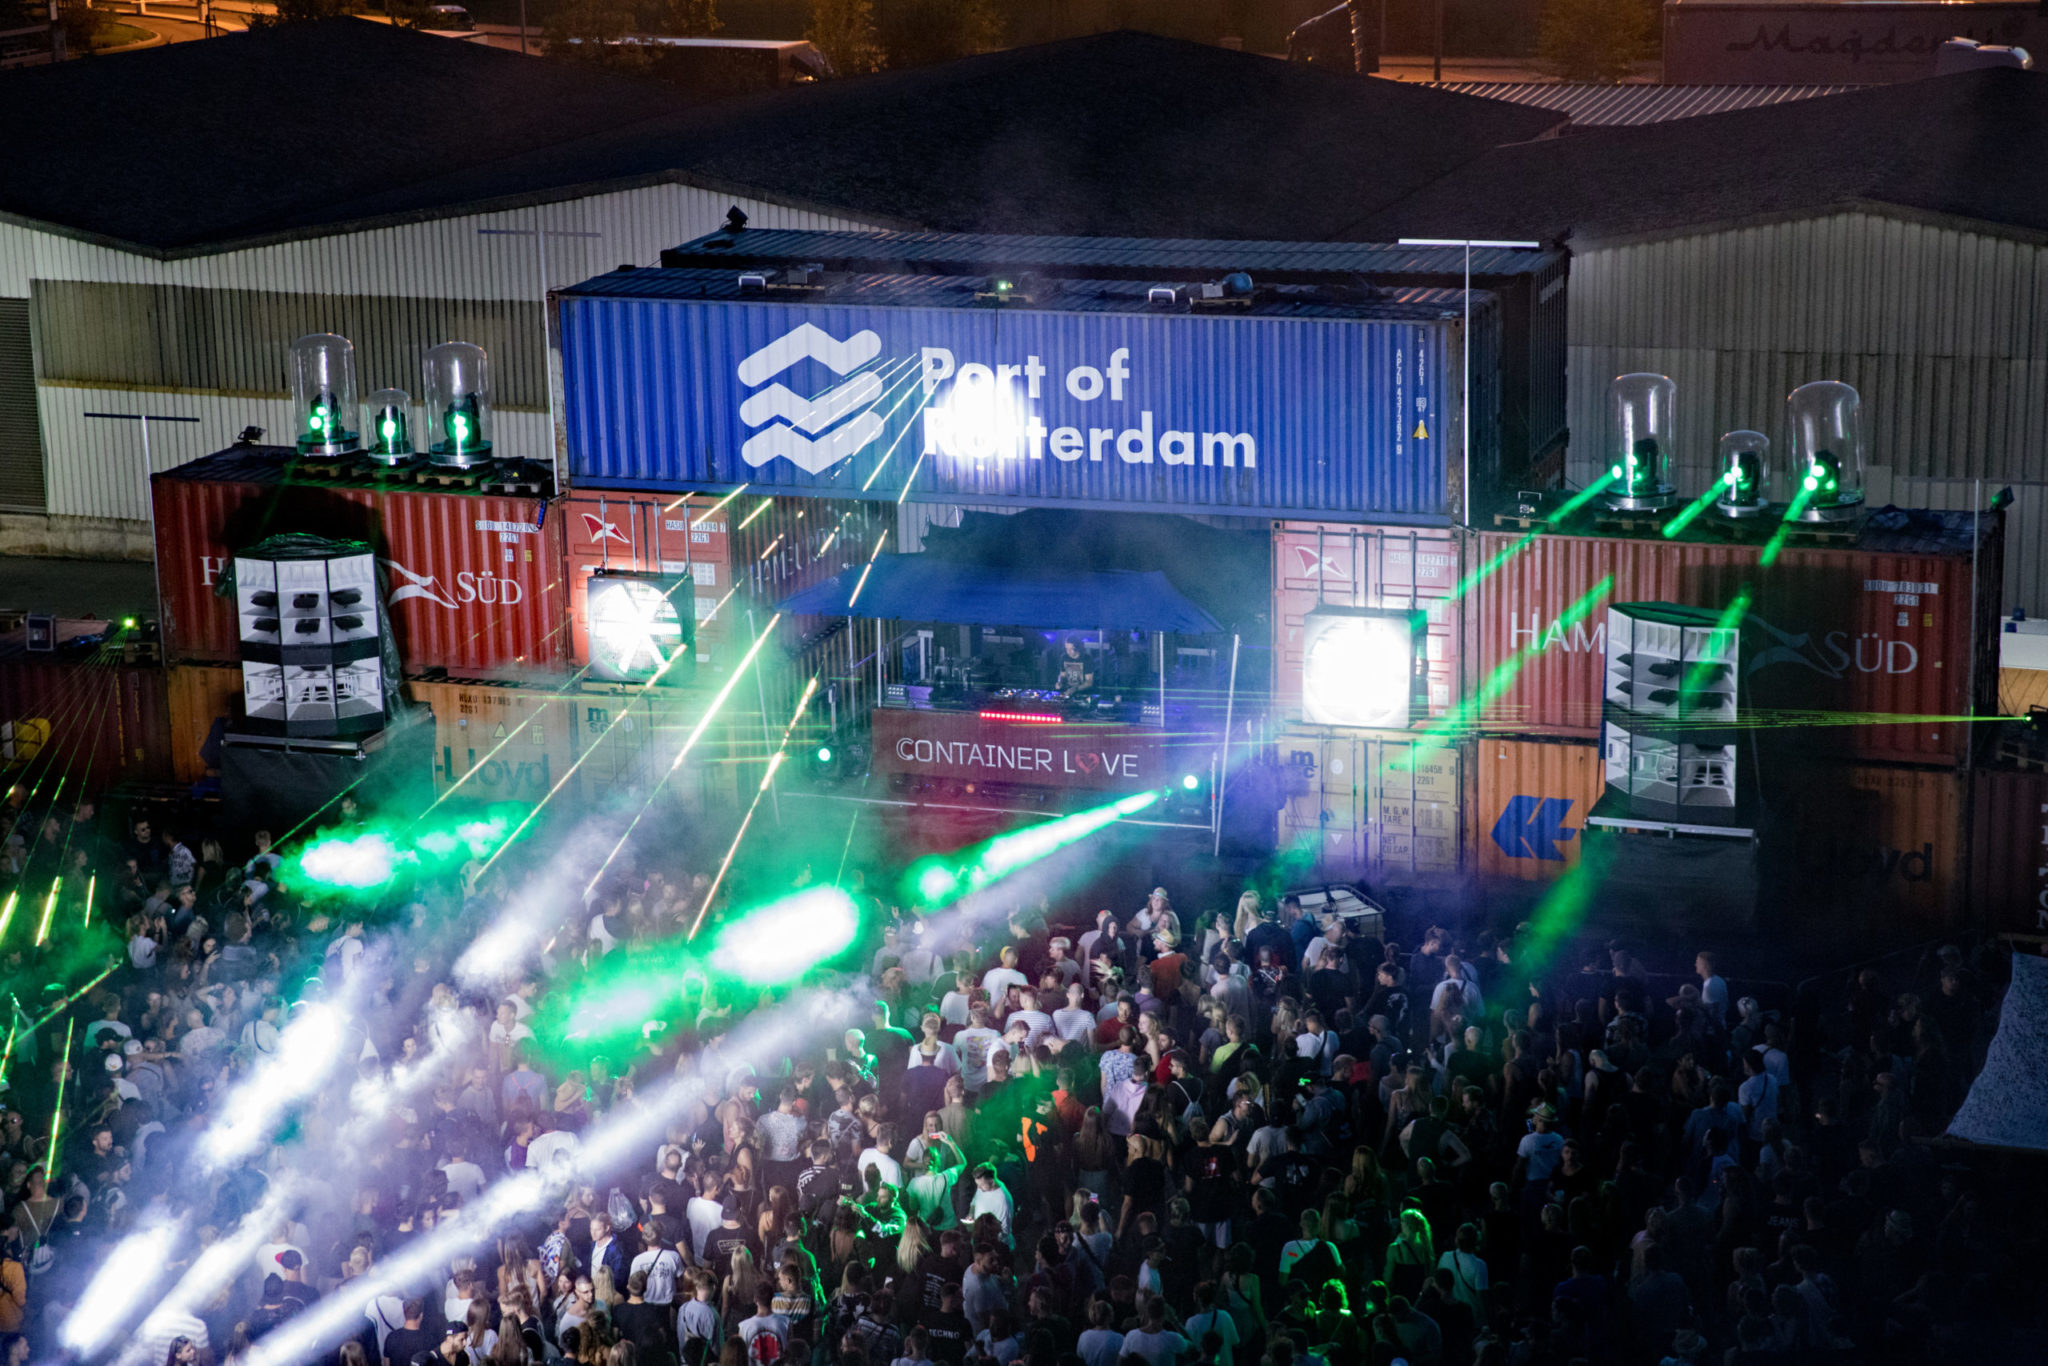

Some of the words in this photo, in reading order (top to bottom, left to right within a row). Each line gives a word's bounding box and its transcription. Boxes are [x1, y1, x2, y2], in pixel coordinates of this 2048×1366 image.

[922, 347, 1046, 399] Port
[1066, 347, 1130, 401] of
[457, 570, 522, 605] SÜD
[1510, 611, 1605, 655] HAM
[1824, 631, 1918, 674] SÜD
[896, 737, 1052, 772] CONTAINER
